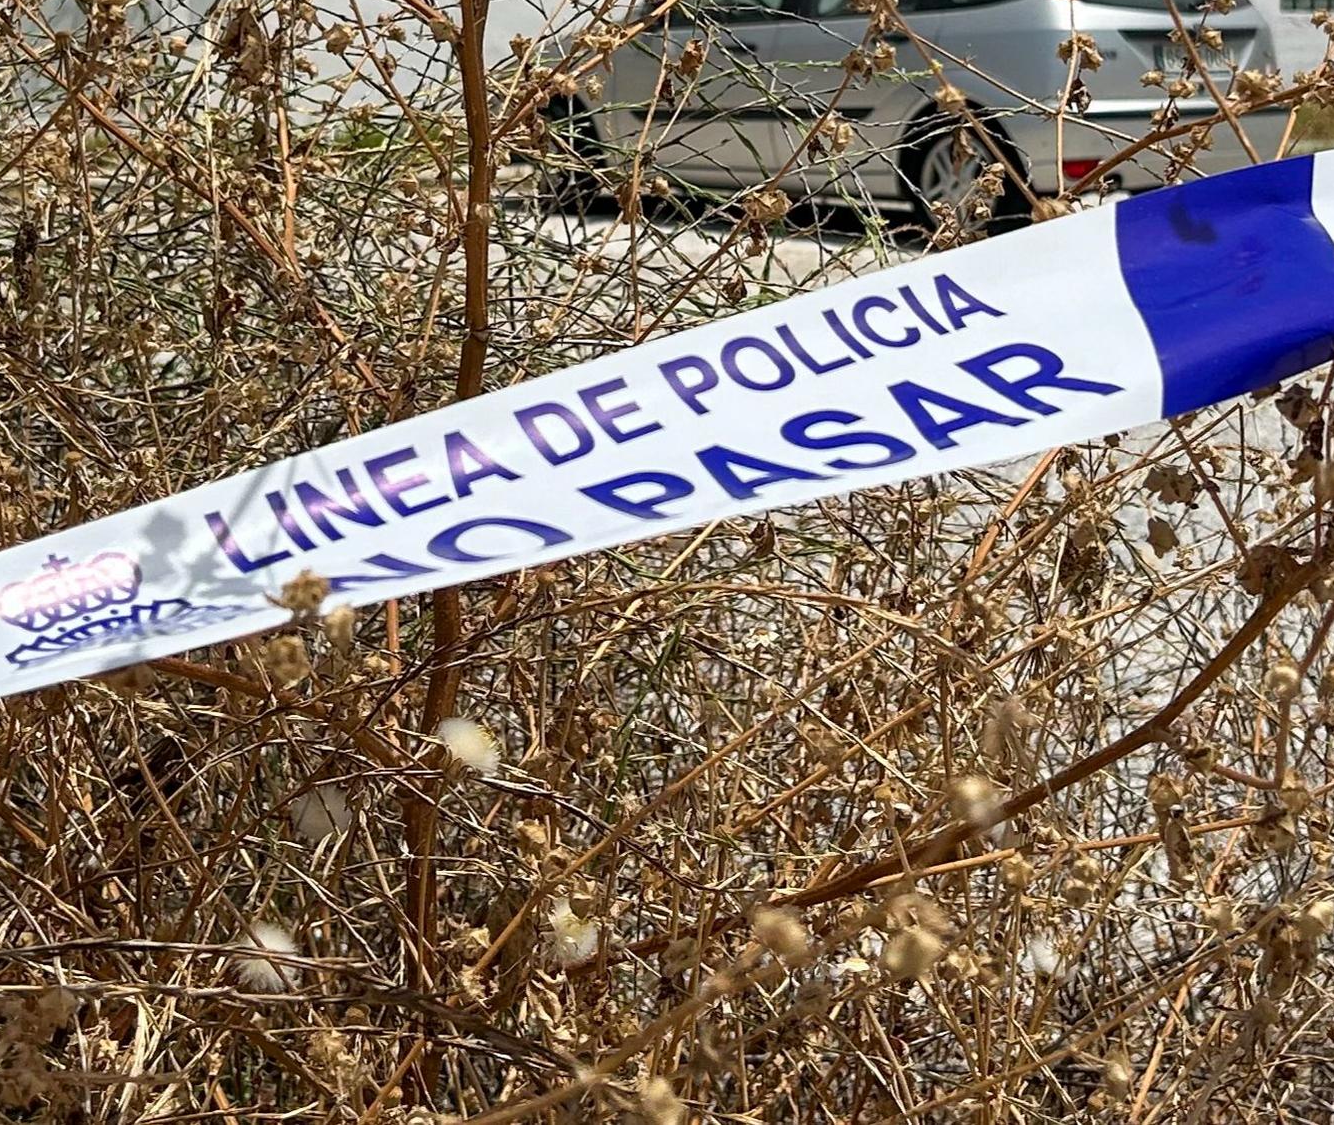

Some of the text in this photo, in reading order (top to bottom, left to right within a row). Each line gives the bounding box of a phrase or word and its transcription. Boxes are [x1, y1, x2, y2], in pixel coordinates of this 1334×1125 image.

[203, 273, 1008, 574] LINEA DE POLICIA
[576, 342, 1127, 521] PASAR
